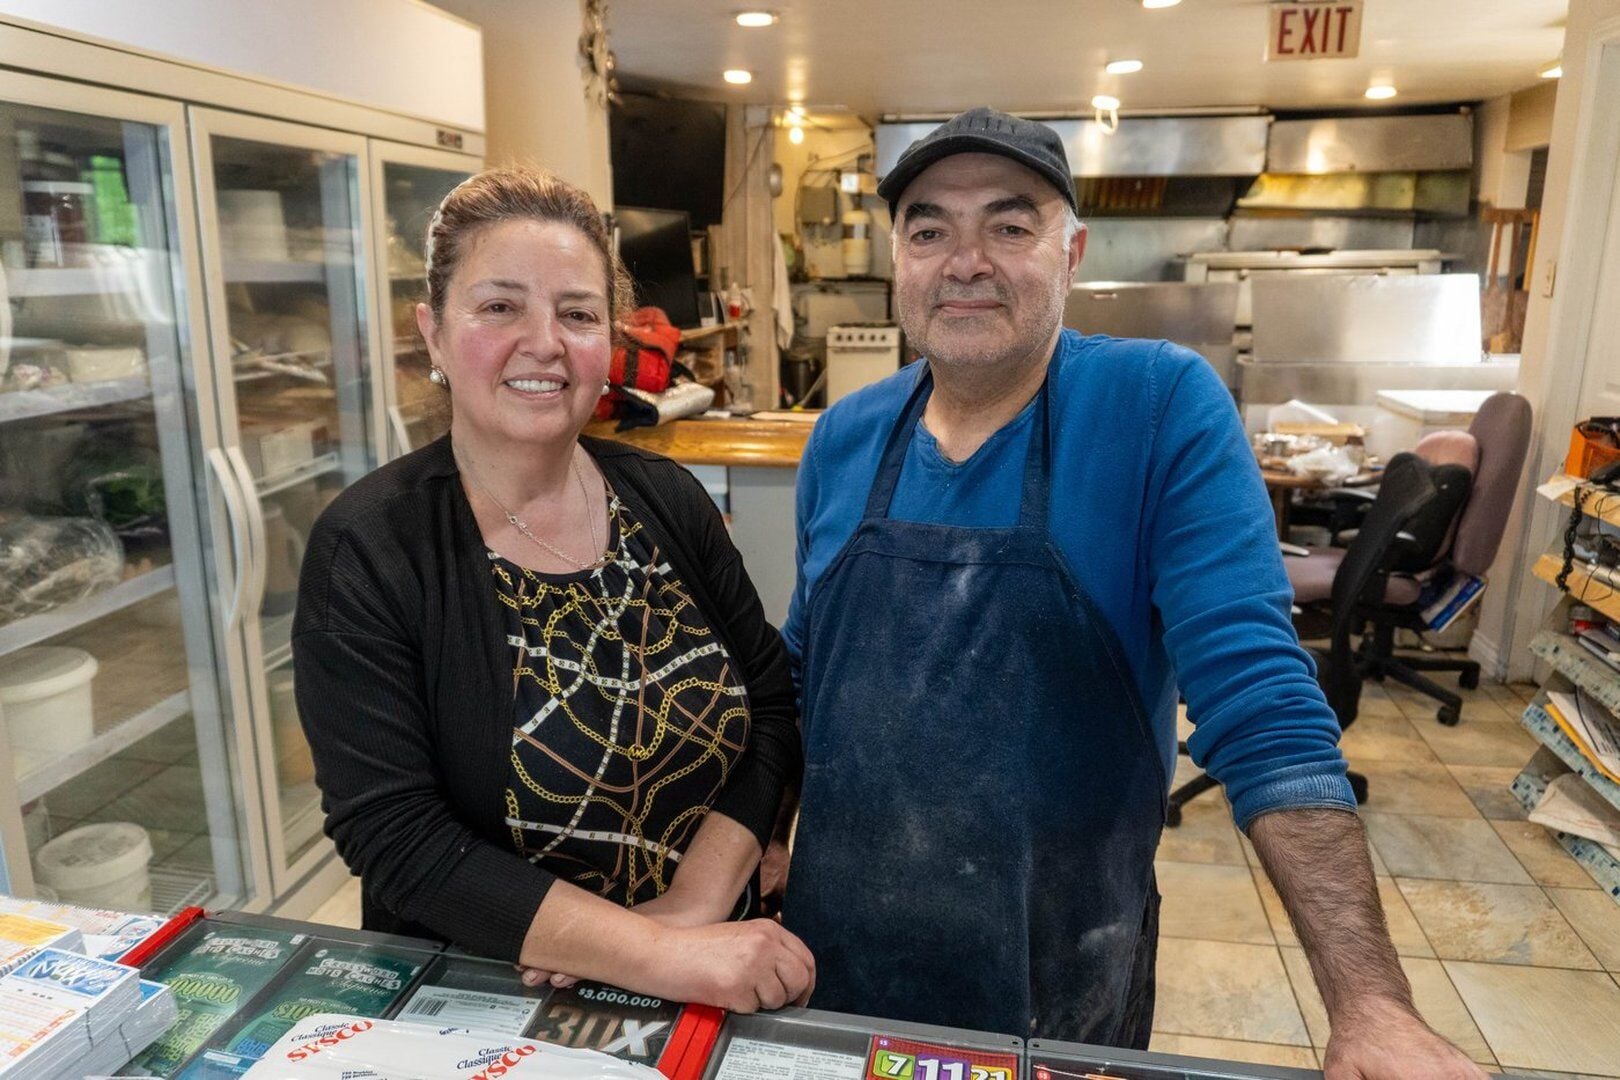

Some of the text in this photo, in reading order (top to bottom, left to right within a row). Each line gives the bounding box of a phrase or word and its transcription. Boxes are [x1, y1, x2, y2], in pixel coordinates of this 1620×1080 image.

[1277, 7, 1353, 54] EXIT
[577, 988, 662, 1008] $3,000,000
[291, 1030, 337, 1042] Classique
[315, 1022, 350, 1033] Classic
[535, 1005, 670, 1056] 30X
[287, 1021, 373, 1062] SYSCO
[478, 1046, 514, 1057] Classic
[457, 1052, 502, 1070] Classique
[887, 1055, 908, 1075] 7
[918, 1059, 964, 1080] 11
